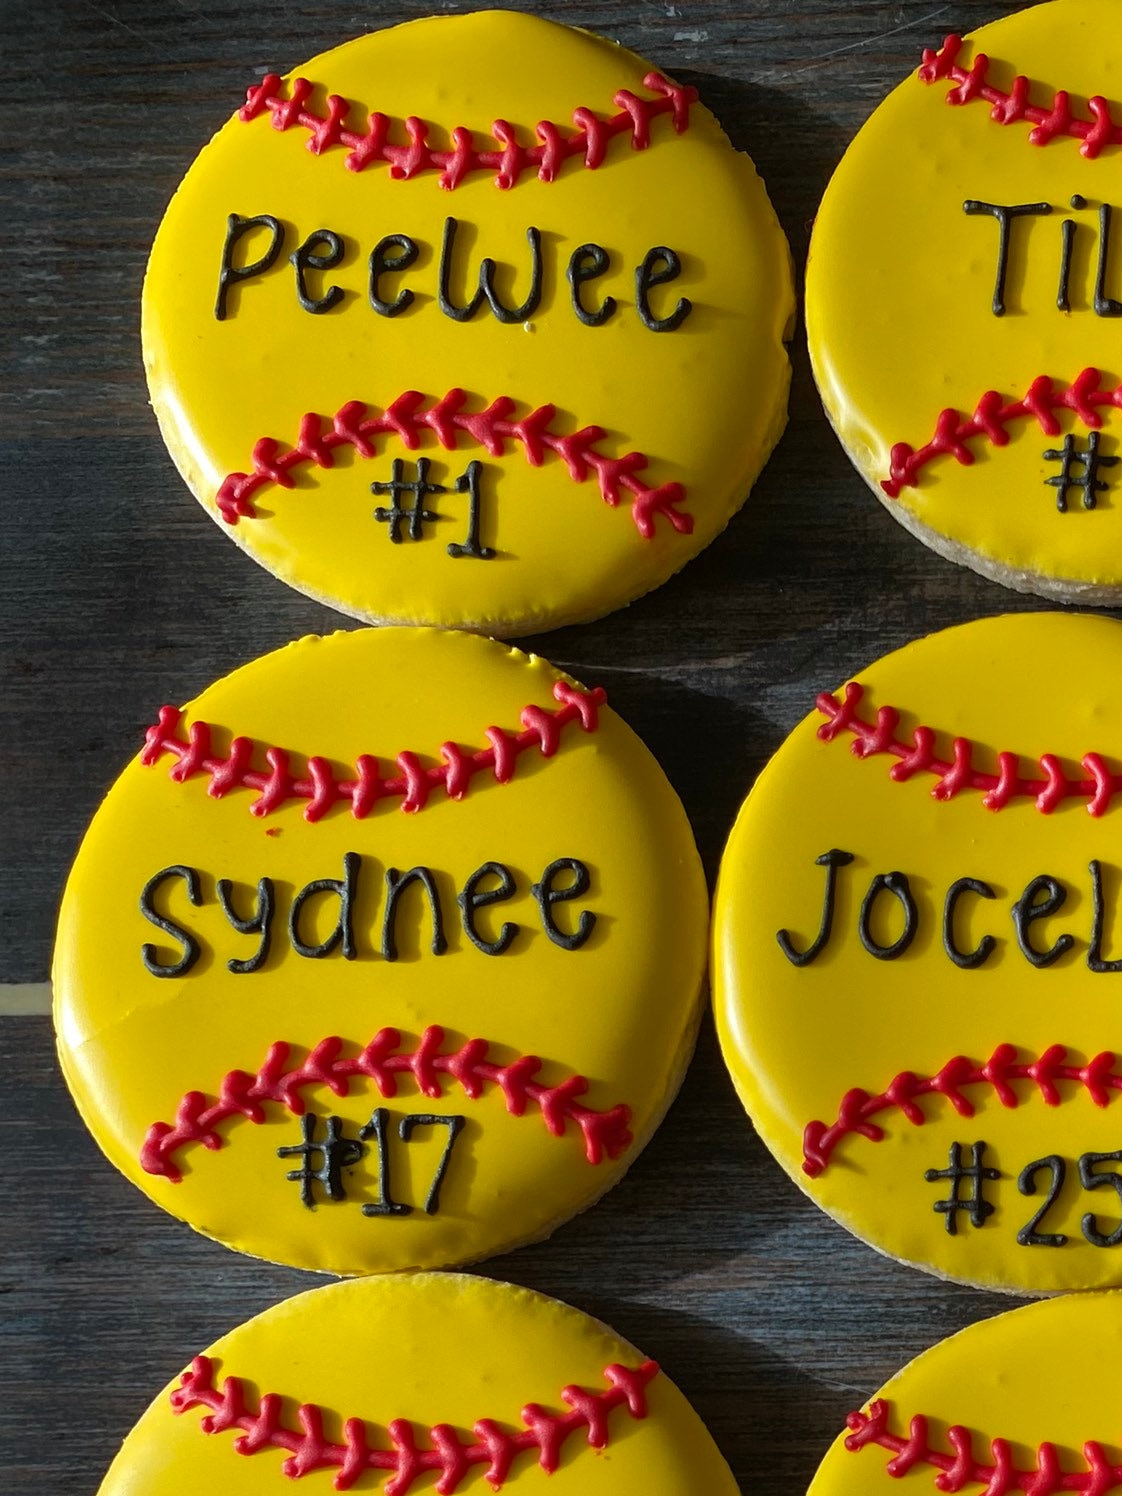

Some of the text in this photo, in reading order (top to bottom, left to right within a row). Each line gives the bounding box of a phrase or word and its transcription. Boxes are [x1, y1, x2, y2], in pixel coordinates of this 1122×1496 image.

[371, 456, 499, 561] #1
[140, 850, 601, 979] Sydnee
[276, 1106, 469, 1218] #17
